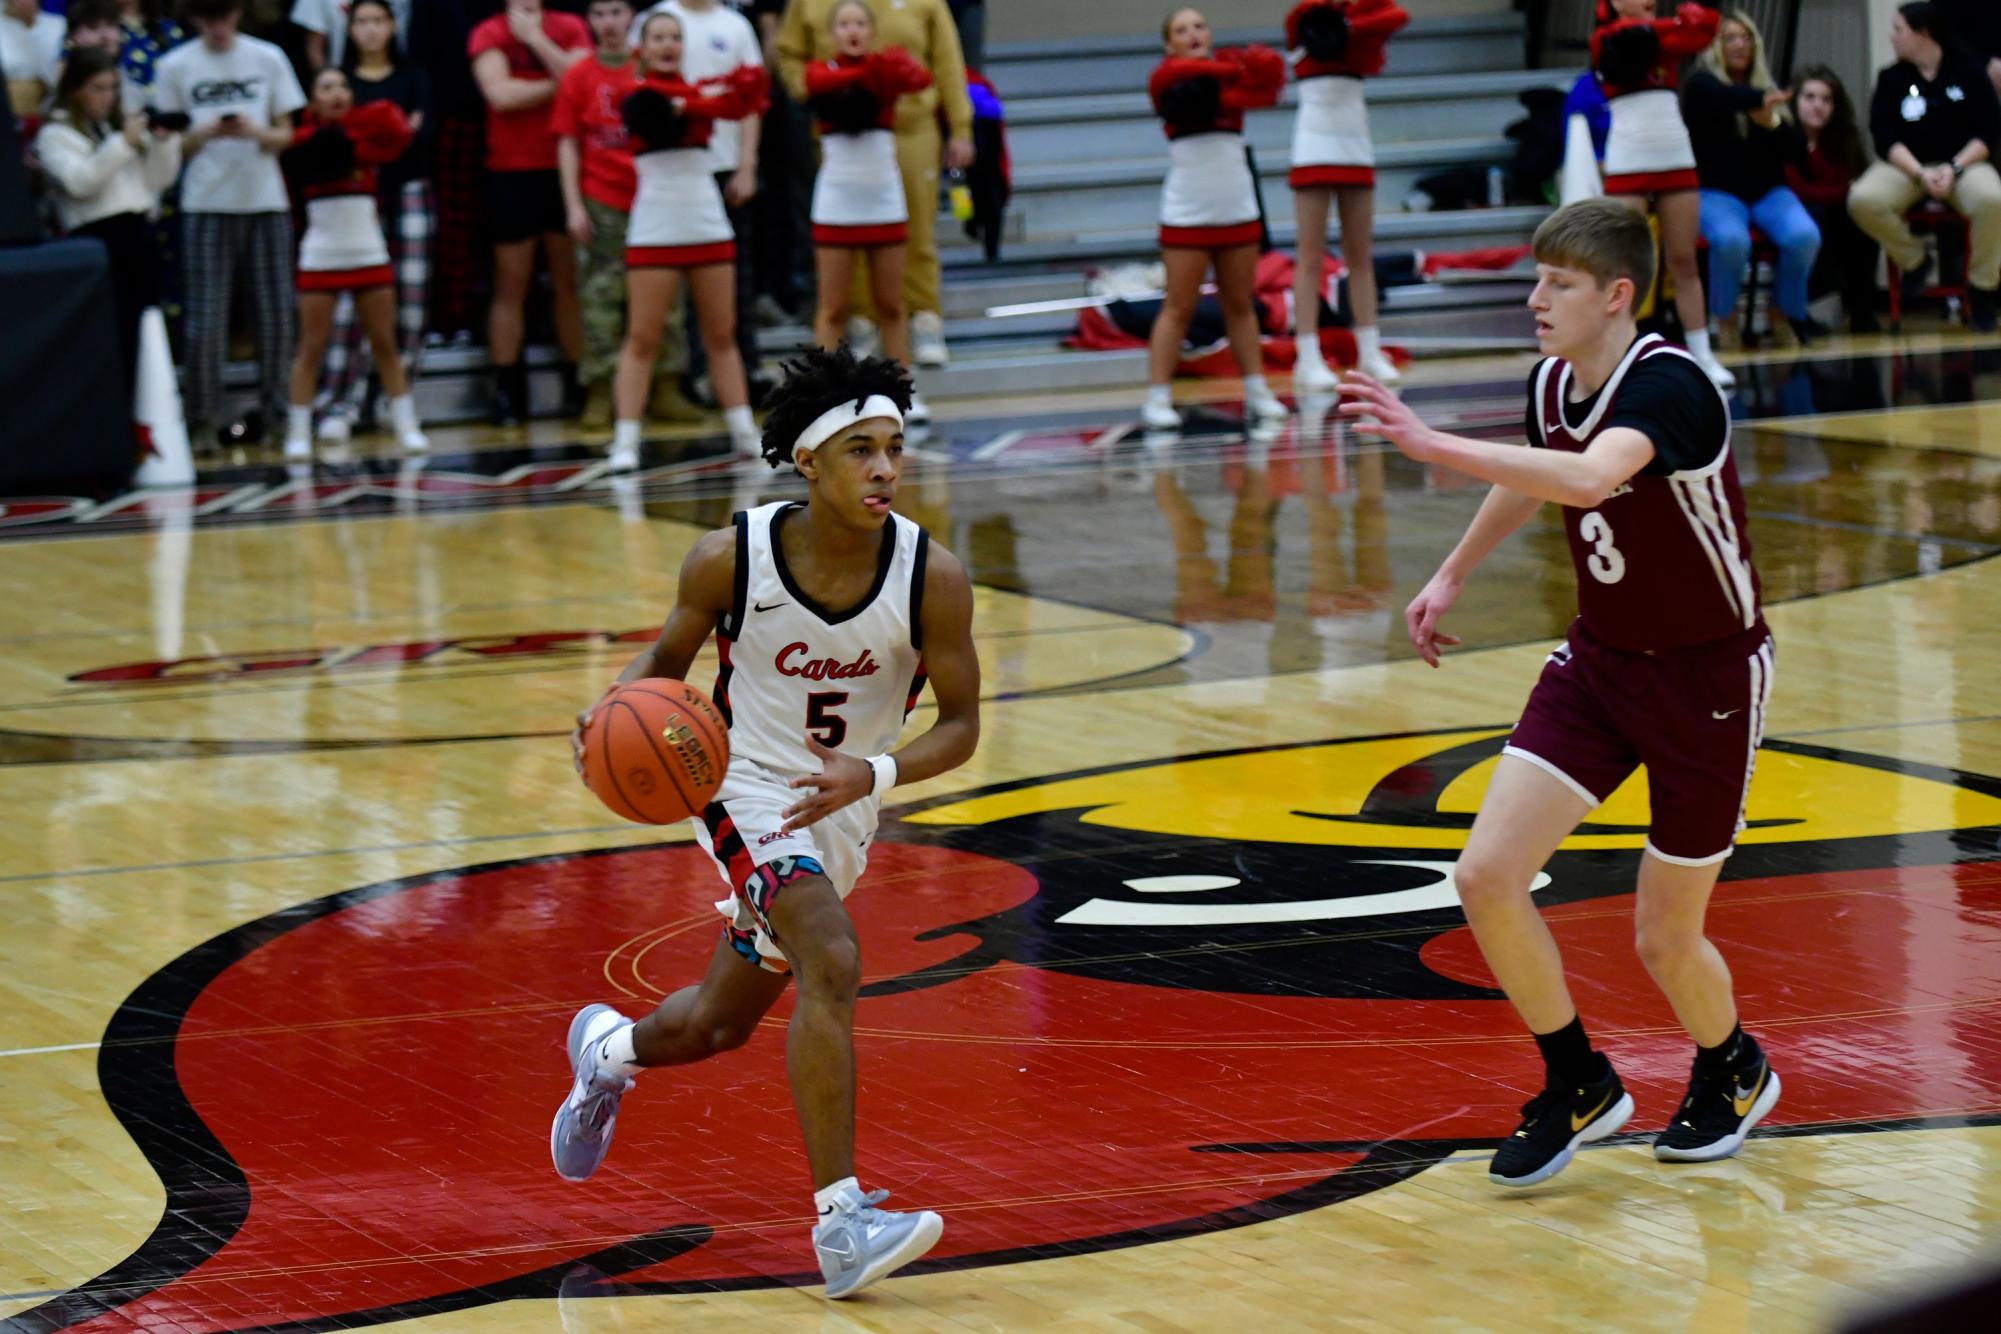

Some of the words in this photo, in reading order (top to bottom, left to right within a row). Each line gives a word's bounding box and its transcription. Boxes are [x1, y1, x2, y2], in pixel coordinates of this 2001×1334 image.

[1580, 511, 1626, 584] 3
[775, 641, 880, 680] Cards
[665, 712, 715, 786] LEGACY
[805, 692, 849, 749] 5
